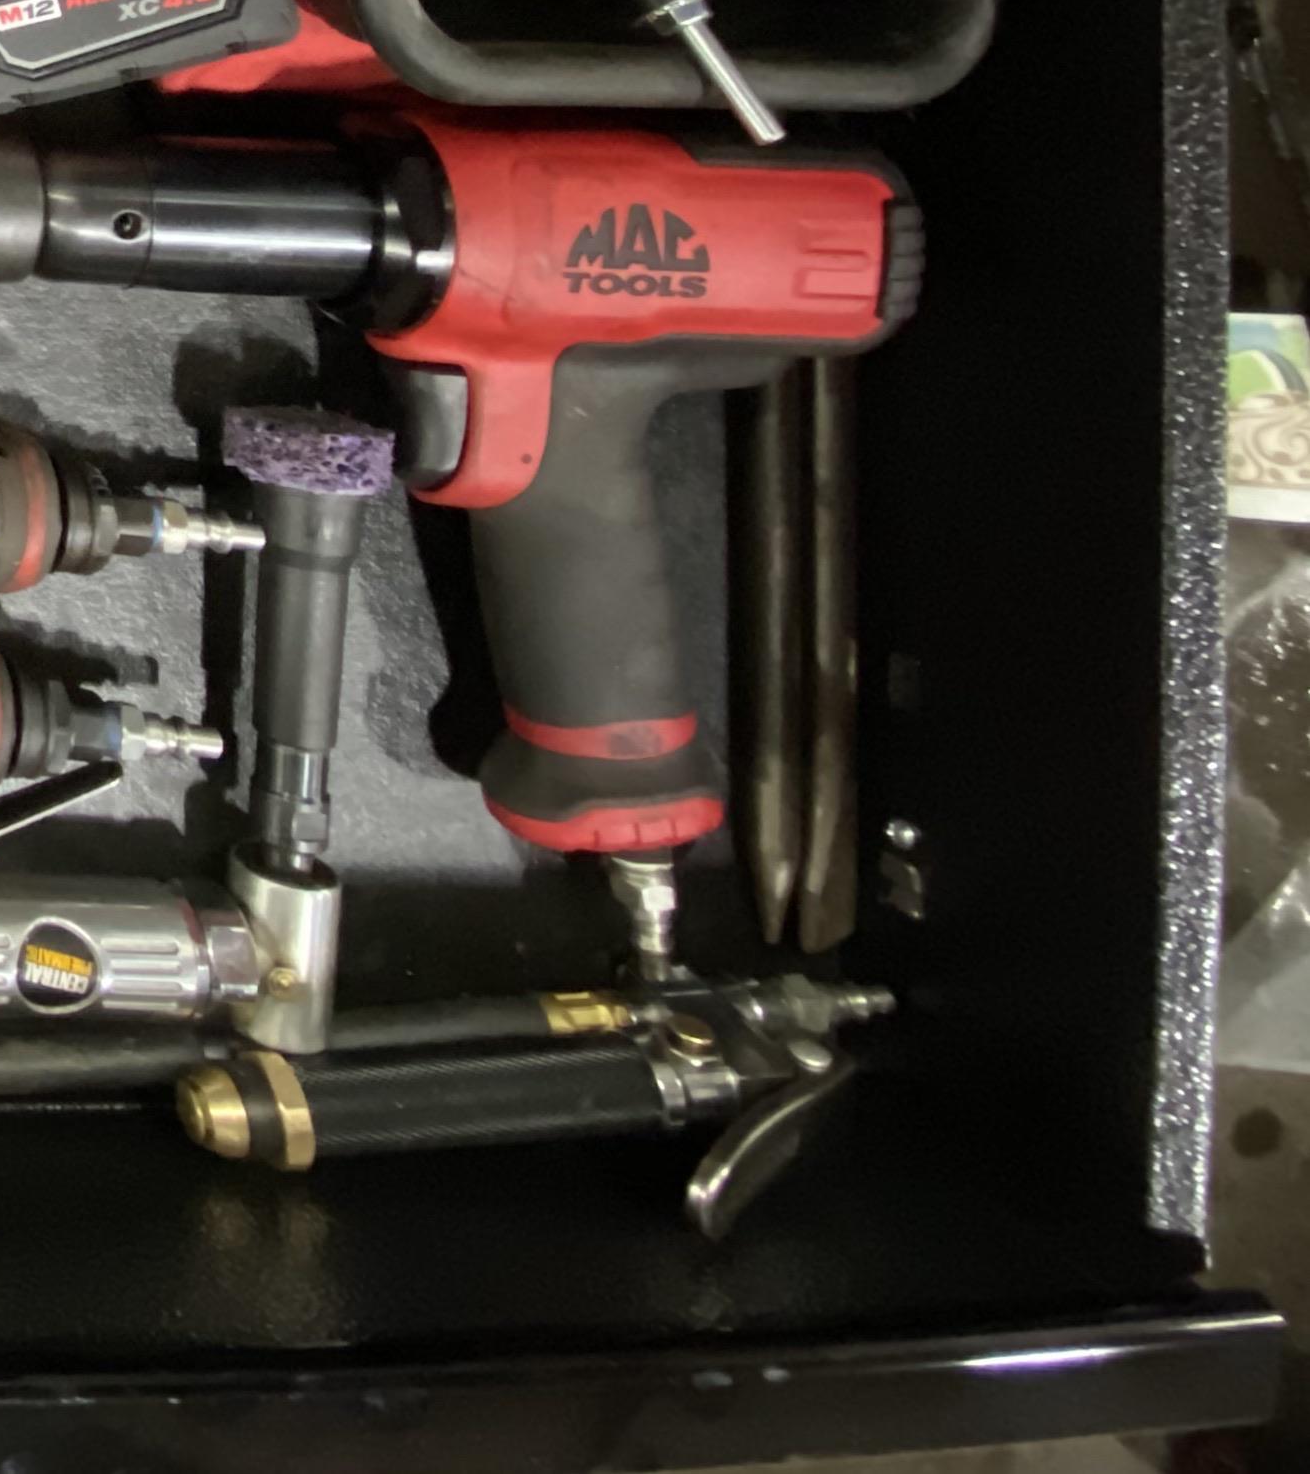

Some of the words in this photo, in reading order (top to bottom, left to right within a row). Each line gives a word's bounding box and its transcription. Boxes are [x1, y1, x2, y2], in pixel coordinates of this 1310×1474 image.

[565, 204, 710, 272] MAC
[563, 272, 709, 298] TOOLS
[25, 962, 89, 994] CENTRAL
